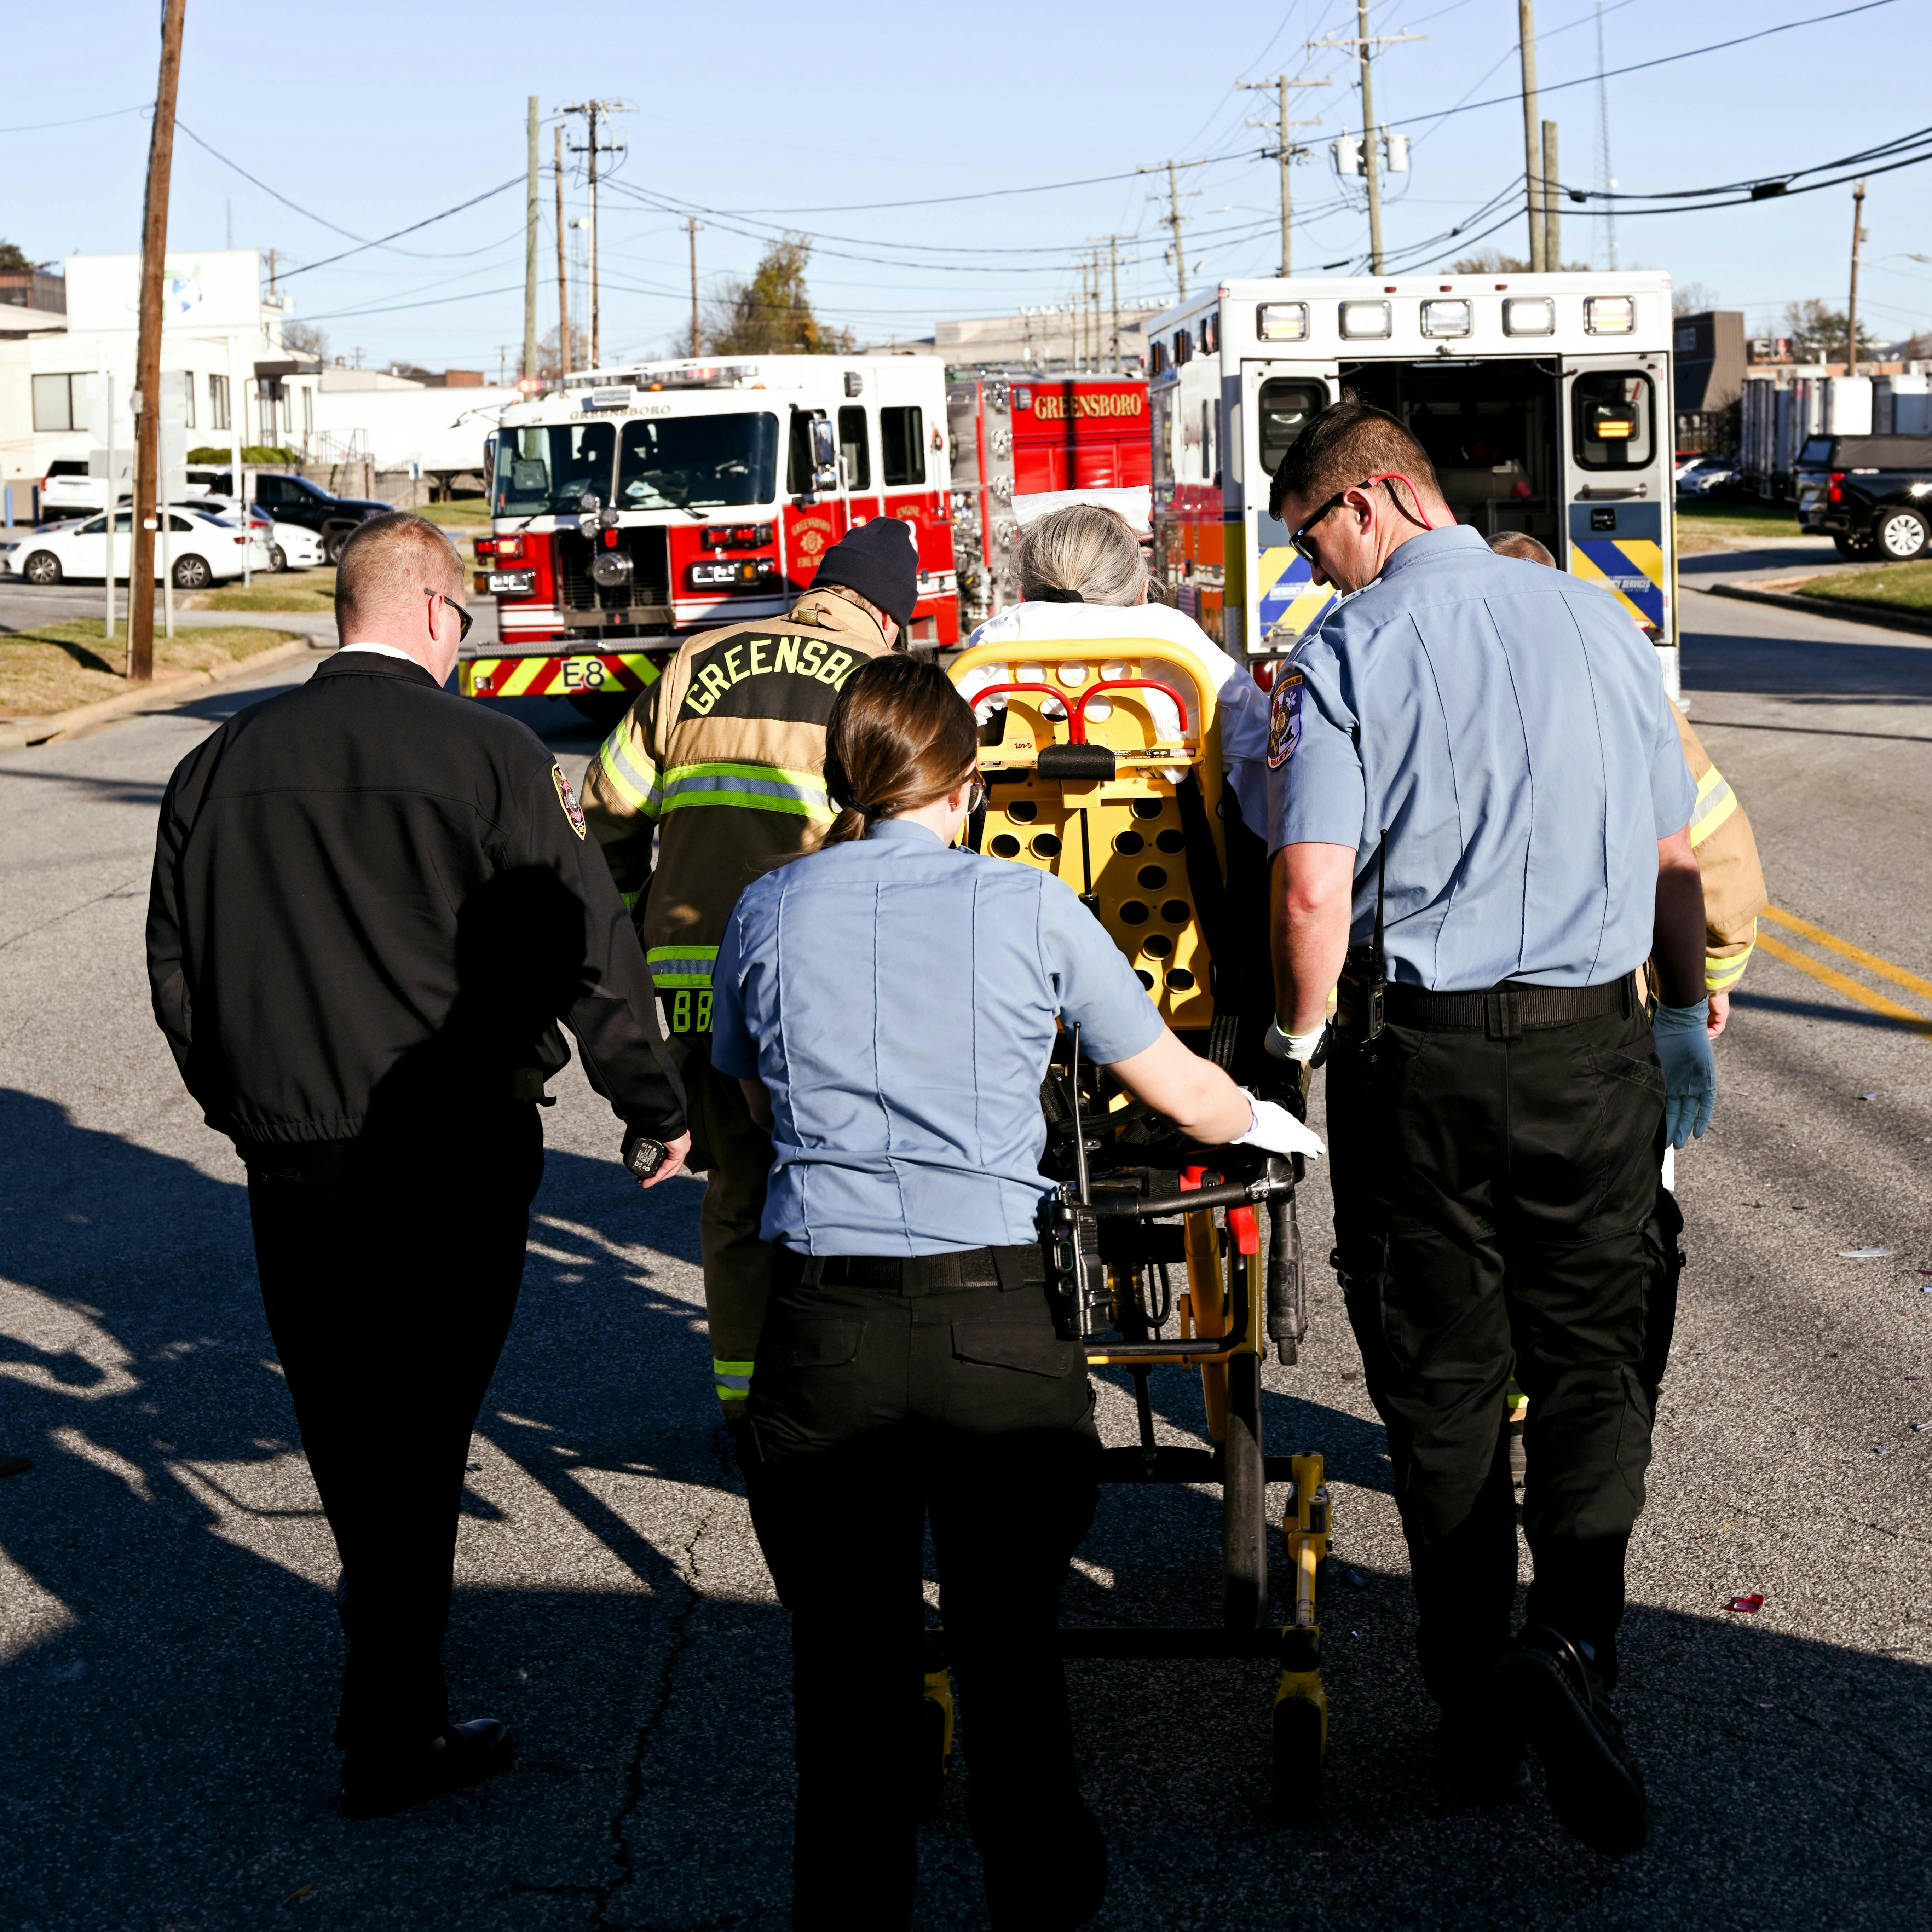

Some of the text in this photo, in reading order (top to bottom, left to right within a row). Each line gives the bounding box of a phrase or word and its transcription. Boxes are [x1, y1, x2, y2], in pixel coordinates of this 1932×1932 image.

[570, 405, 671, 420] GREENSBORO
[1034, 393, 1142, 420] GREENSBORO
[1622, 579, 1650, 589] SERVICES
[563, 661, 605, 687] E8
[1271, 746, 1291, 766] PARAMEDIC
